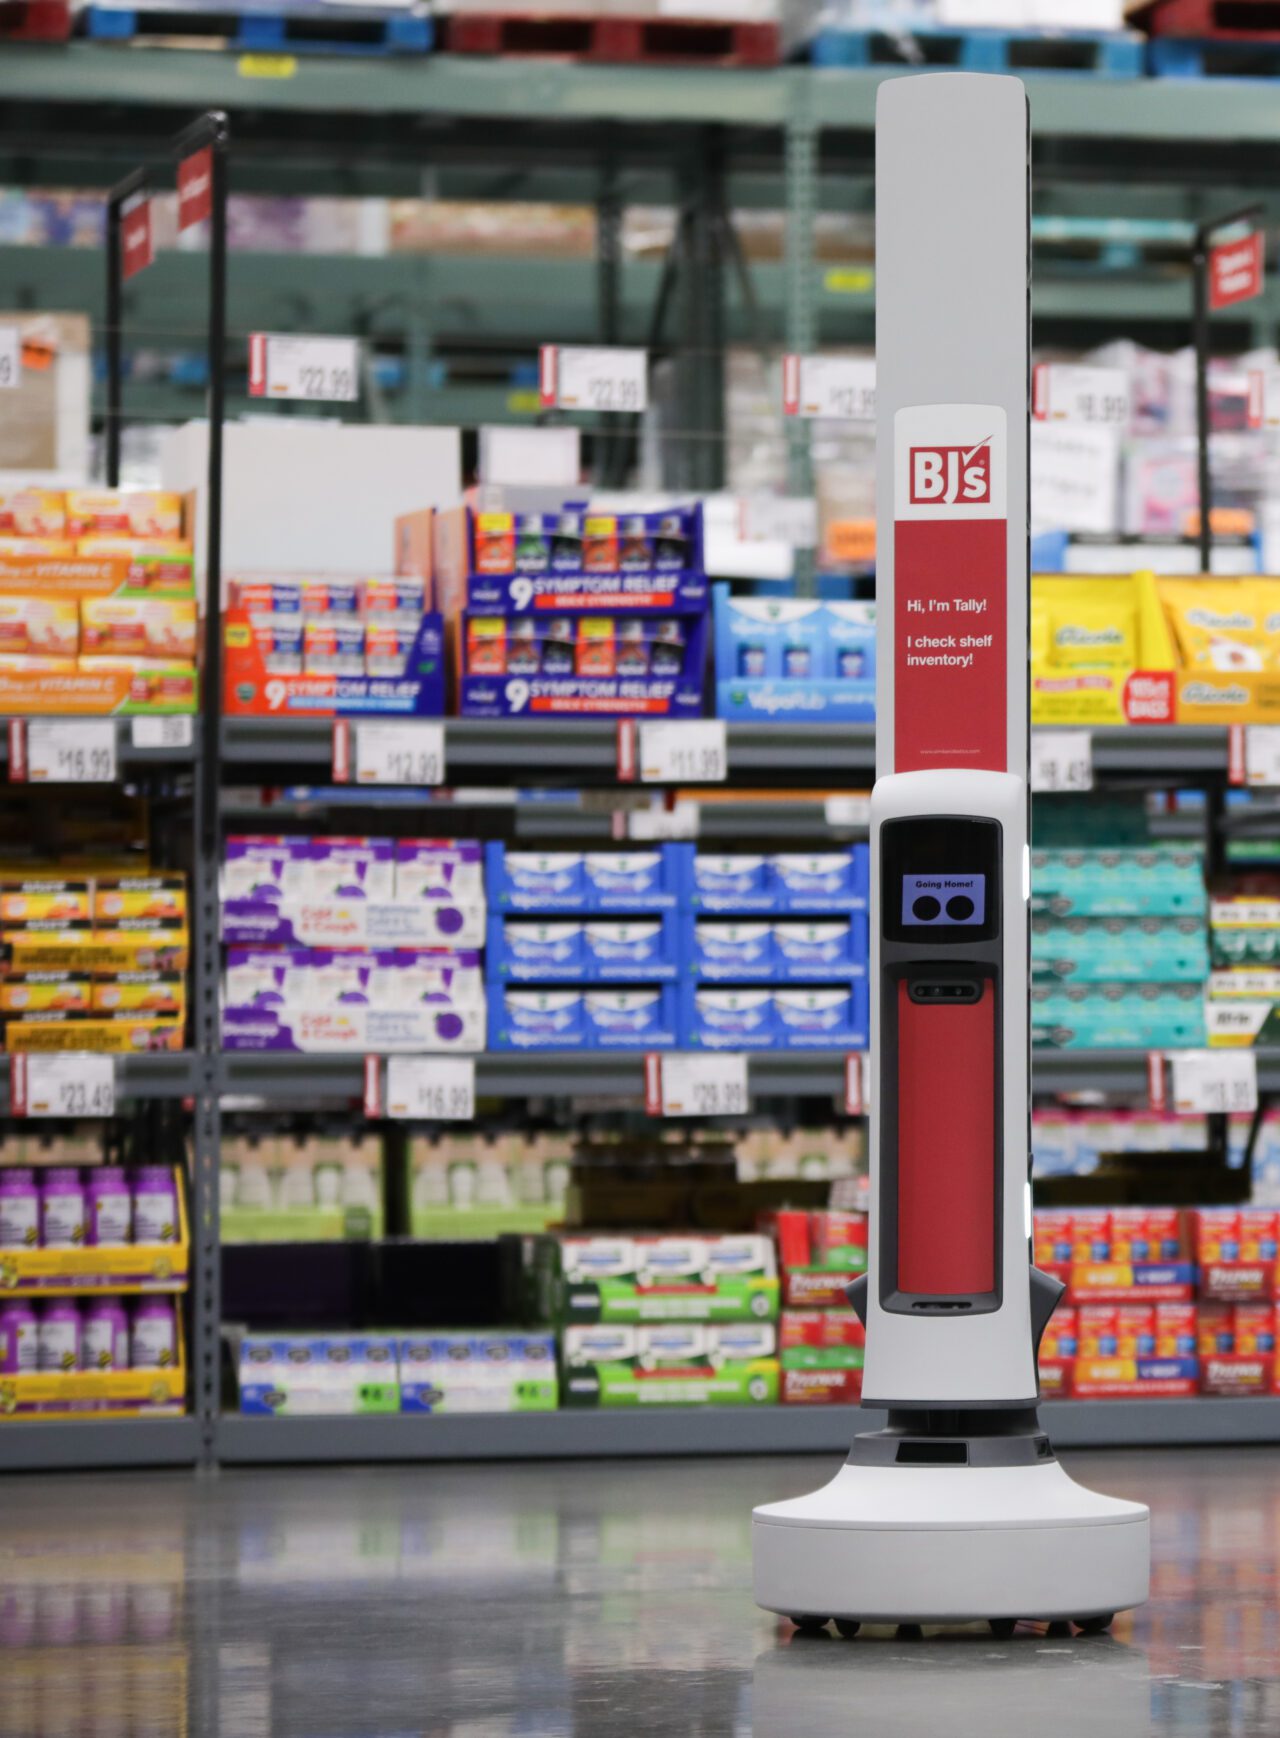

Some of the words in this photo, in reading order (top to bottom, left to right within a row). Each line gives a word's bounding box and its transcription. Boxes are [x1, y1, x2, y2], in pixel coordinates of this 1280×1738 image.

[508, 576, 535, 611] 9
[534, 577, 621, 594] SYMPTOM
[623, 574, 679, 593] RELIEF
[907, 599, 925, 614] Hi,
[928, 599, 952, 613] I'm
[953, 599, 987, 614] Tally!
[914, 635, 957, 648] check
[959, 634, 993, 648] shelf
[907, 653, 974, 668] inventory!
[264, 679, 287, 711] 9
[505, 678, 531, 713] 9
[530, 679, 617, 697] SYMPTOM
[619, 678, 675, 698] RELIEF
[387, 752, 438, 782] $12.99
[915, 880, 942, 890] Going
[944, 880, 974, 889] Home!
[60, 1083, 113, 1114] $23.49
